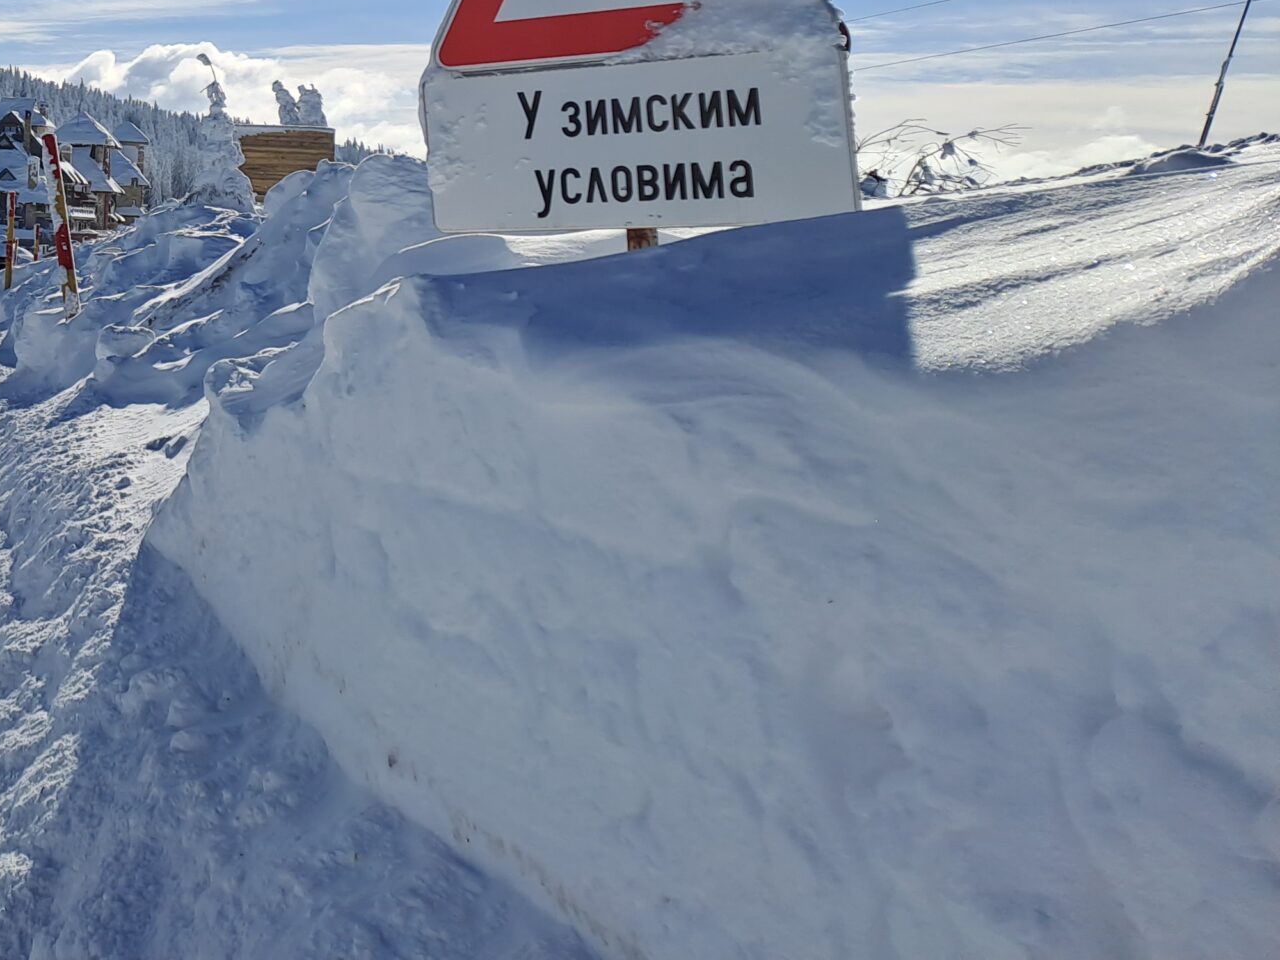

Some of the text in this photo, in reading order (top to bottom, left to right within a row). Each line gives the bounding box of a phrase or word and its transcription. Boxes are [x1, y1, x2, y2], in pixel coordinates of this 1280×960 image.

[517, 87, 762, 139] У зимским
[534, 159, 755, 218] условима
